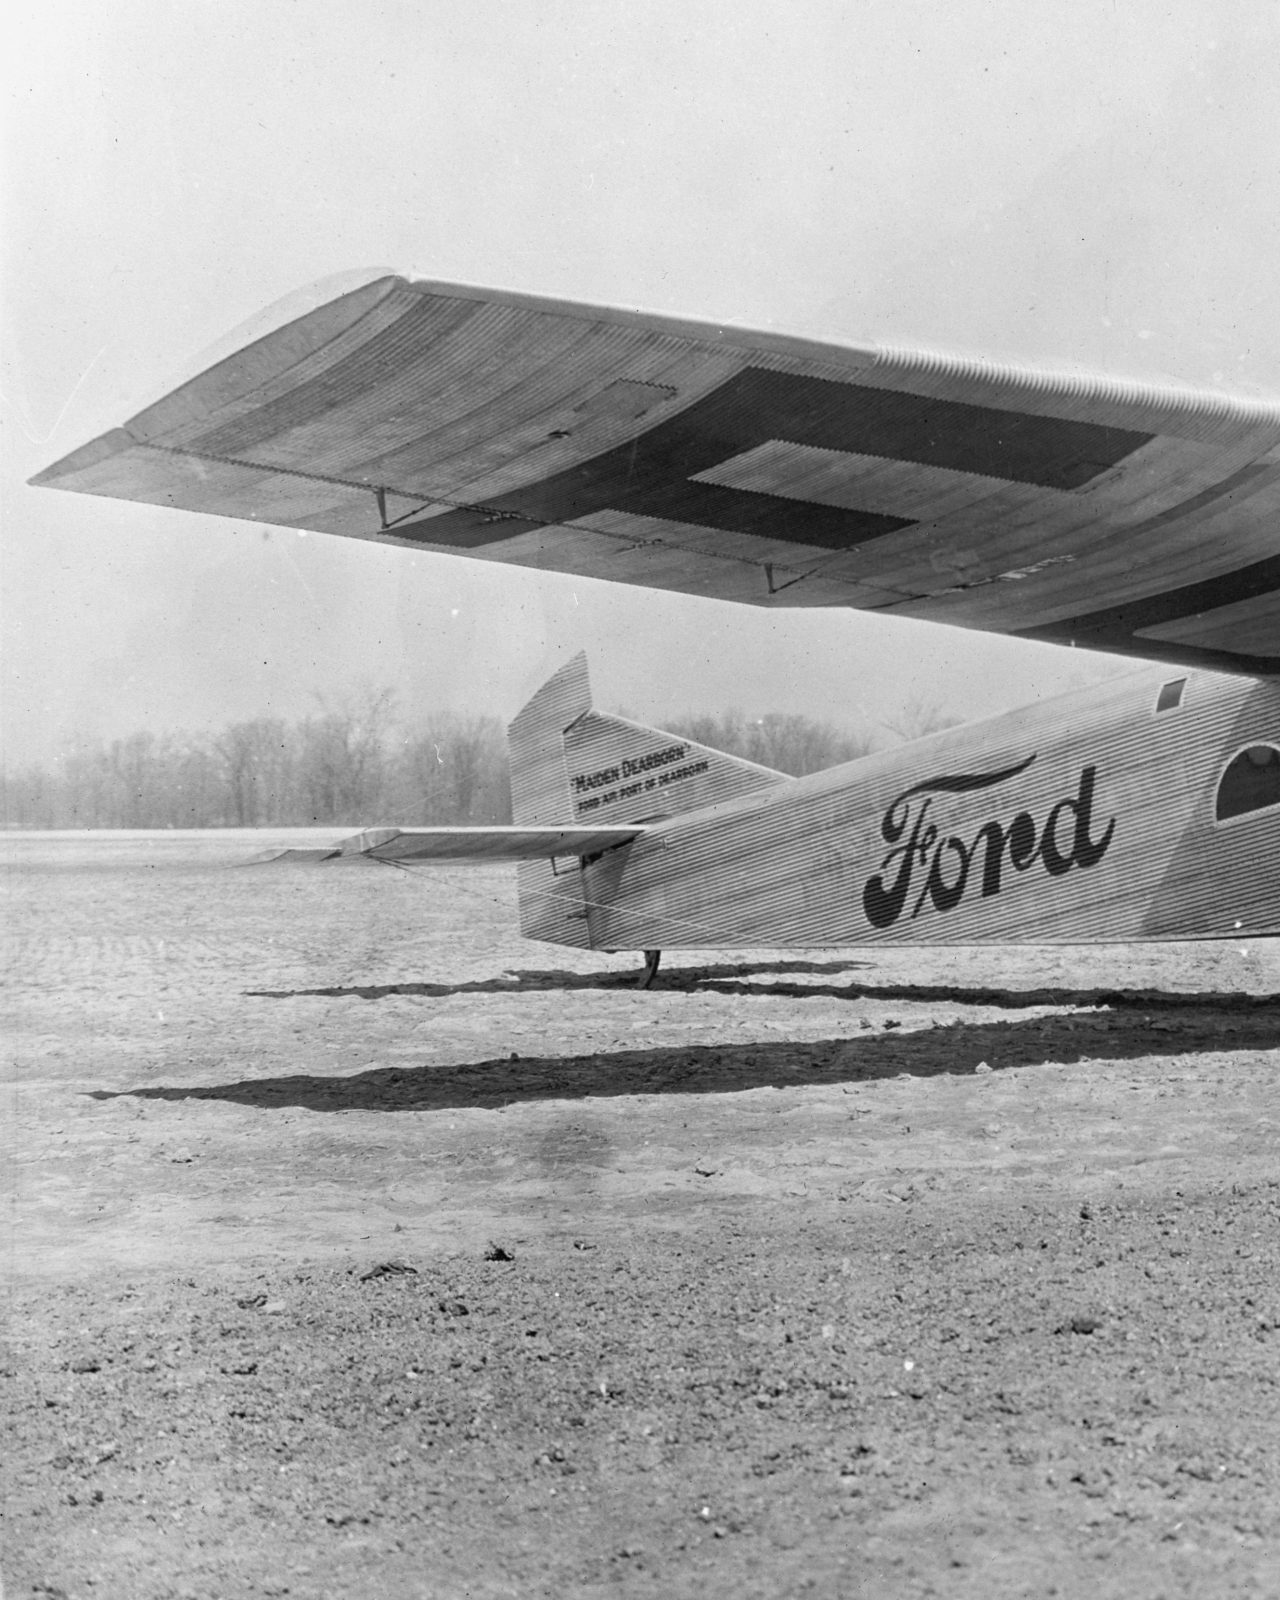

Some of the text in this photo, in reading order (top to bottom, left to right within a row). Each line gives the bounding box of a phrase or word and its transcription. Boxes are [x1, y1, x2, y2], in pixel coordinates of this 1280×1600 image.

[619, 782, 642, 800] PORT
[645, 778, 657, 791] OF
[658, 760, 709, 787] DEARBORN
[863, 752, 1116, 929] Ford
